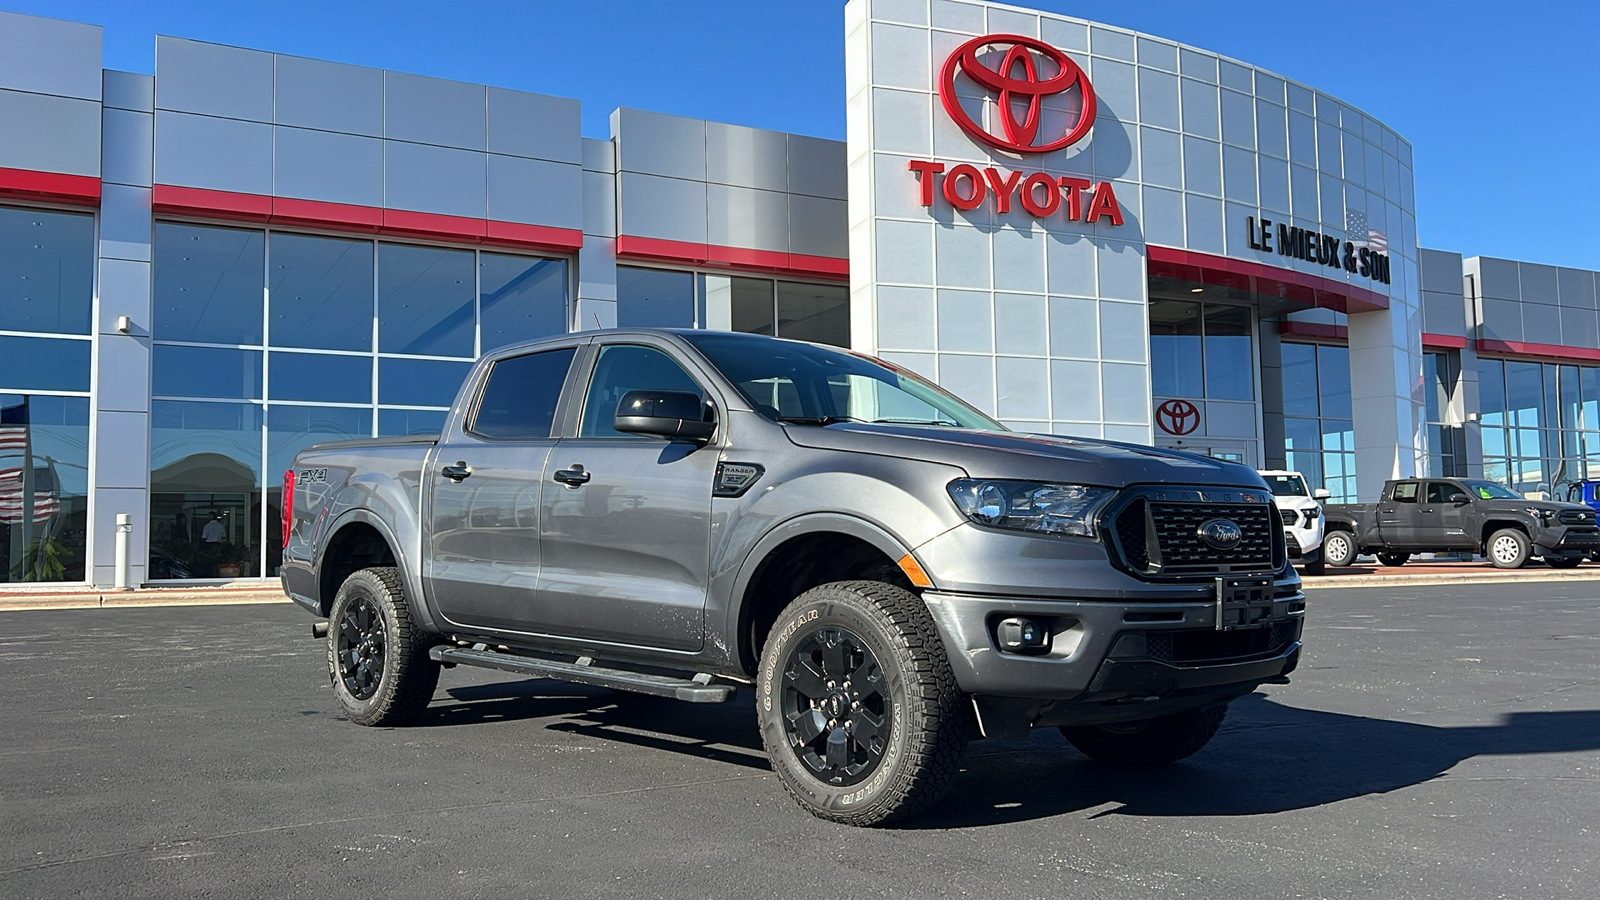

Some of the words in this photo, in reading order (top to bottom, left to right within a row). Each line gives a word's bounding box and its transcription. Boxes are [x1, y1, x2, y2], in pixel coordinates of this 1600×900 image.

[908, 160, 1124, 226] TOYOTA
[1247, 216, 1273, 253] LE
[1277, 222, 1341, 269] MIEUX
[1344, 241, 1358, 274] &
[1359, 247, 1391, 285] SON
[297, 468, 328, 486] FX4
[1155, 492, 1266, 503] RANGER
[1214, 524, 1239, 541] Ford
[763, 609, 819, 712] GOODYEAR
[842, 703, 902, 805] WRANGLER
